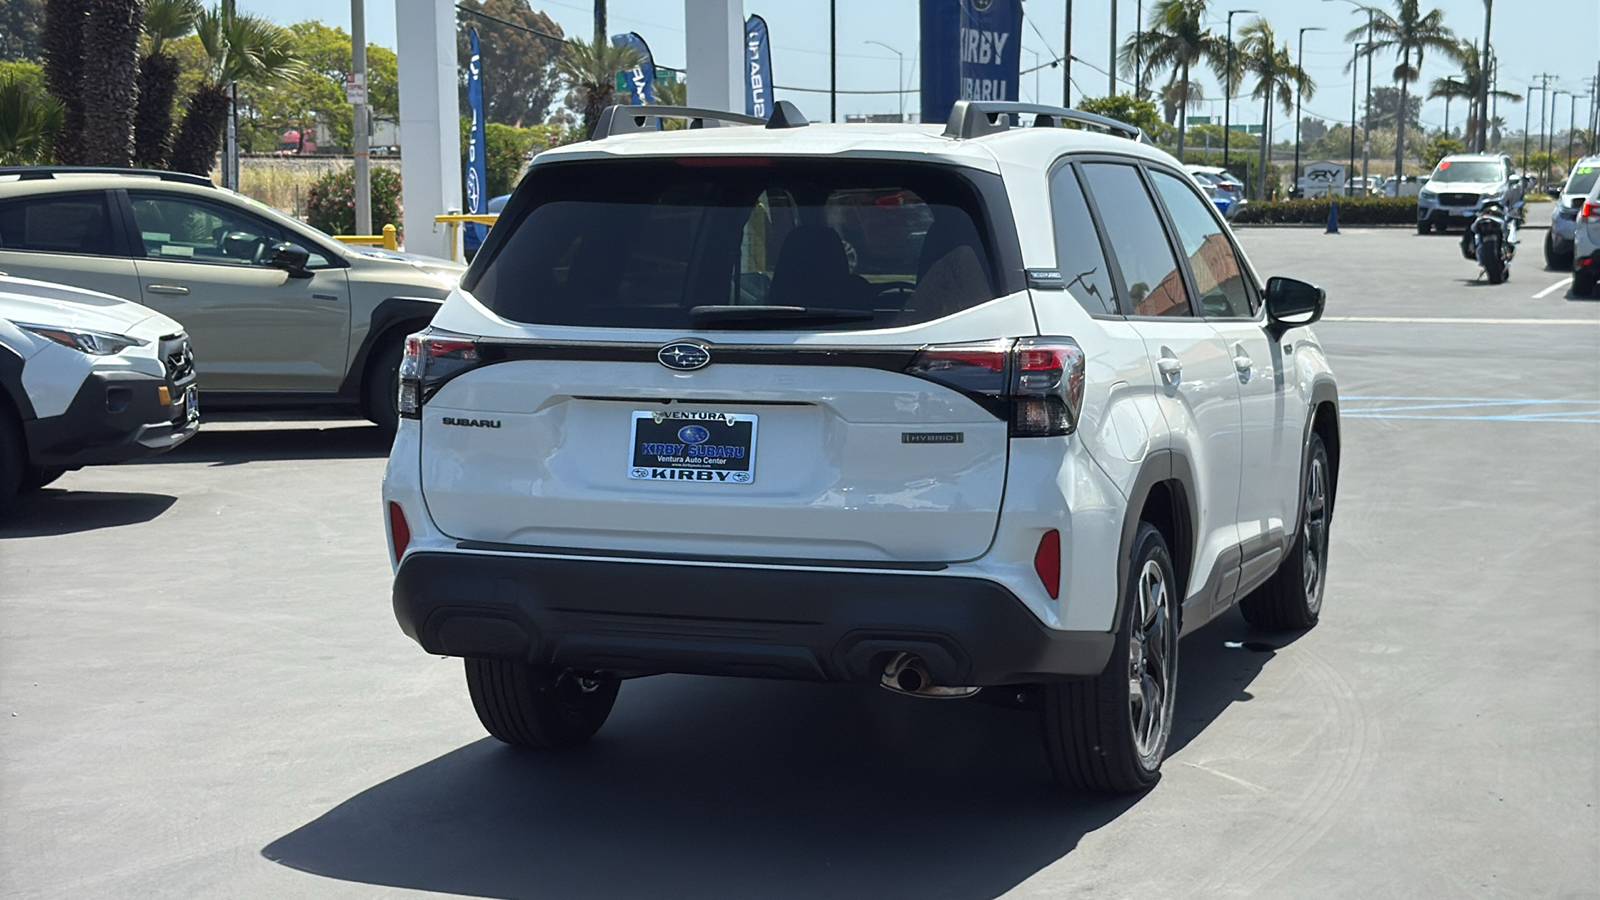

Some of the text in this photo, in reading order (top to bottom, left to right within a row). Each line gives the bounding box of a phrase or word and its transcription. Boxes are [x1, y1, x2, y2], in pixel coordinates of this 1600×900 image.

[961, 77, 1006, 101] UBARU
[665, 411, 726, 420] VENTURA
[442, 417, 502, 428] SUBARU
[642, 443, 745, 458] KIRBY SUBARU
[657, 455, 727, 465] Ventura Auto Center
[651, 469, 731, 481] KIRBY
